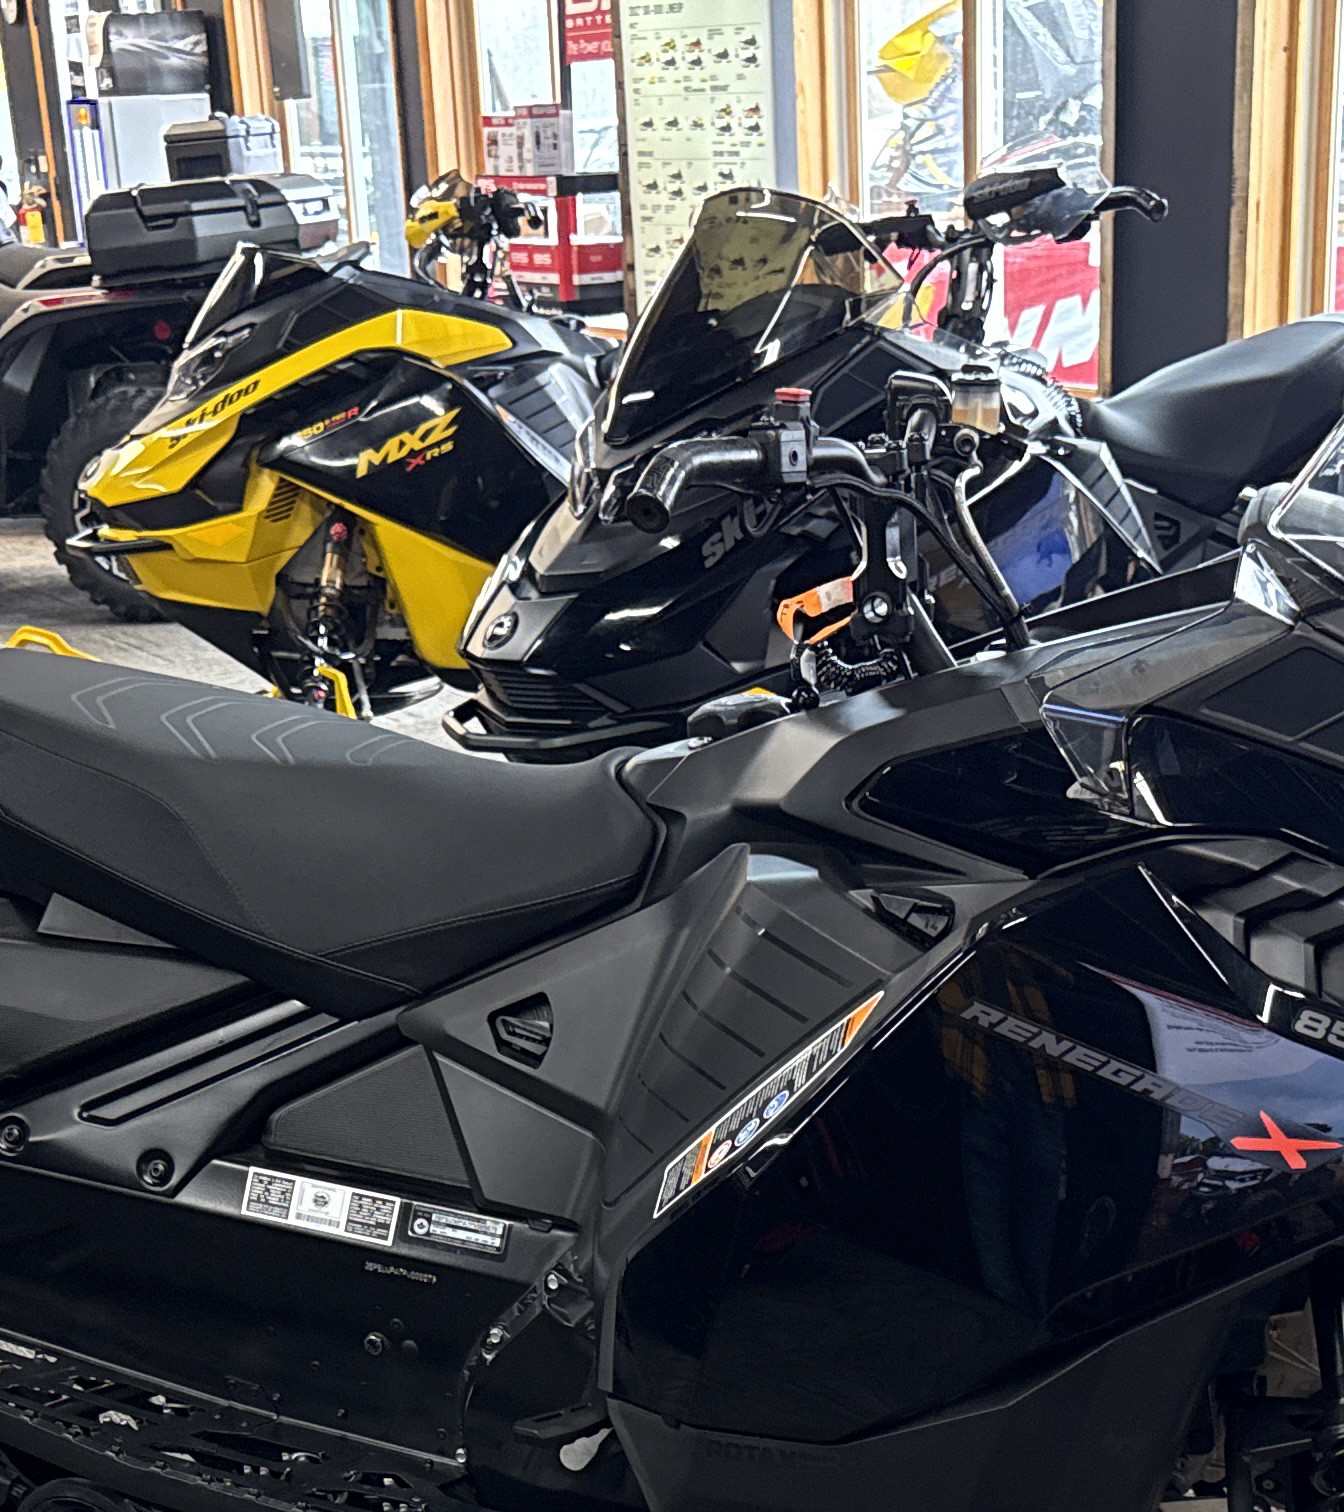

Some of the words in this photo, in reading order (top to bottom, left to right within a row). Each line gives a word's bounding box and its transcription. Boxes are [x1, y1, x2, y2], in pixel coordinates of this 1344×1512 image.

[356, 408, 462, 479] MXZ
[405, 440, 455, 472] XRS
[959, 1001, 1246, 1129] RENEGADE
[1230, 1110, 1344, 1170] X
